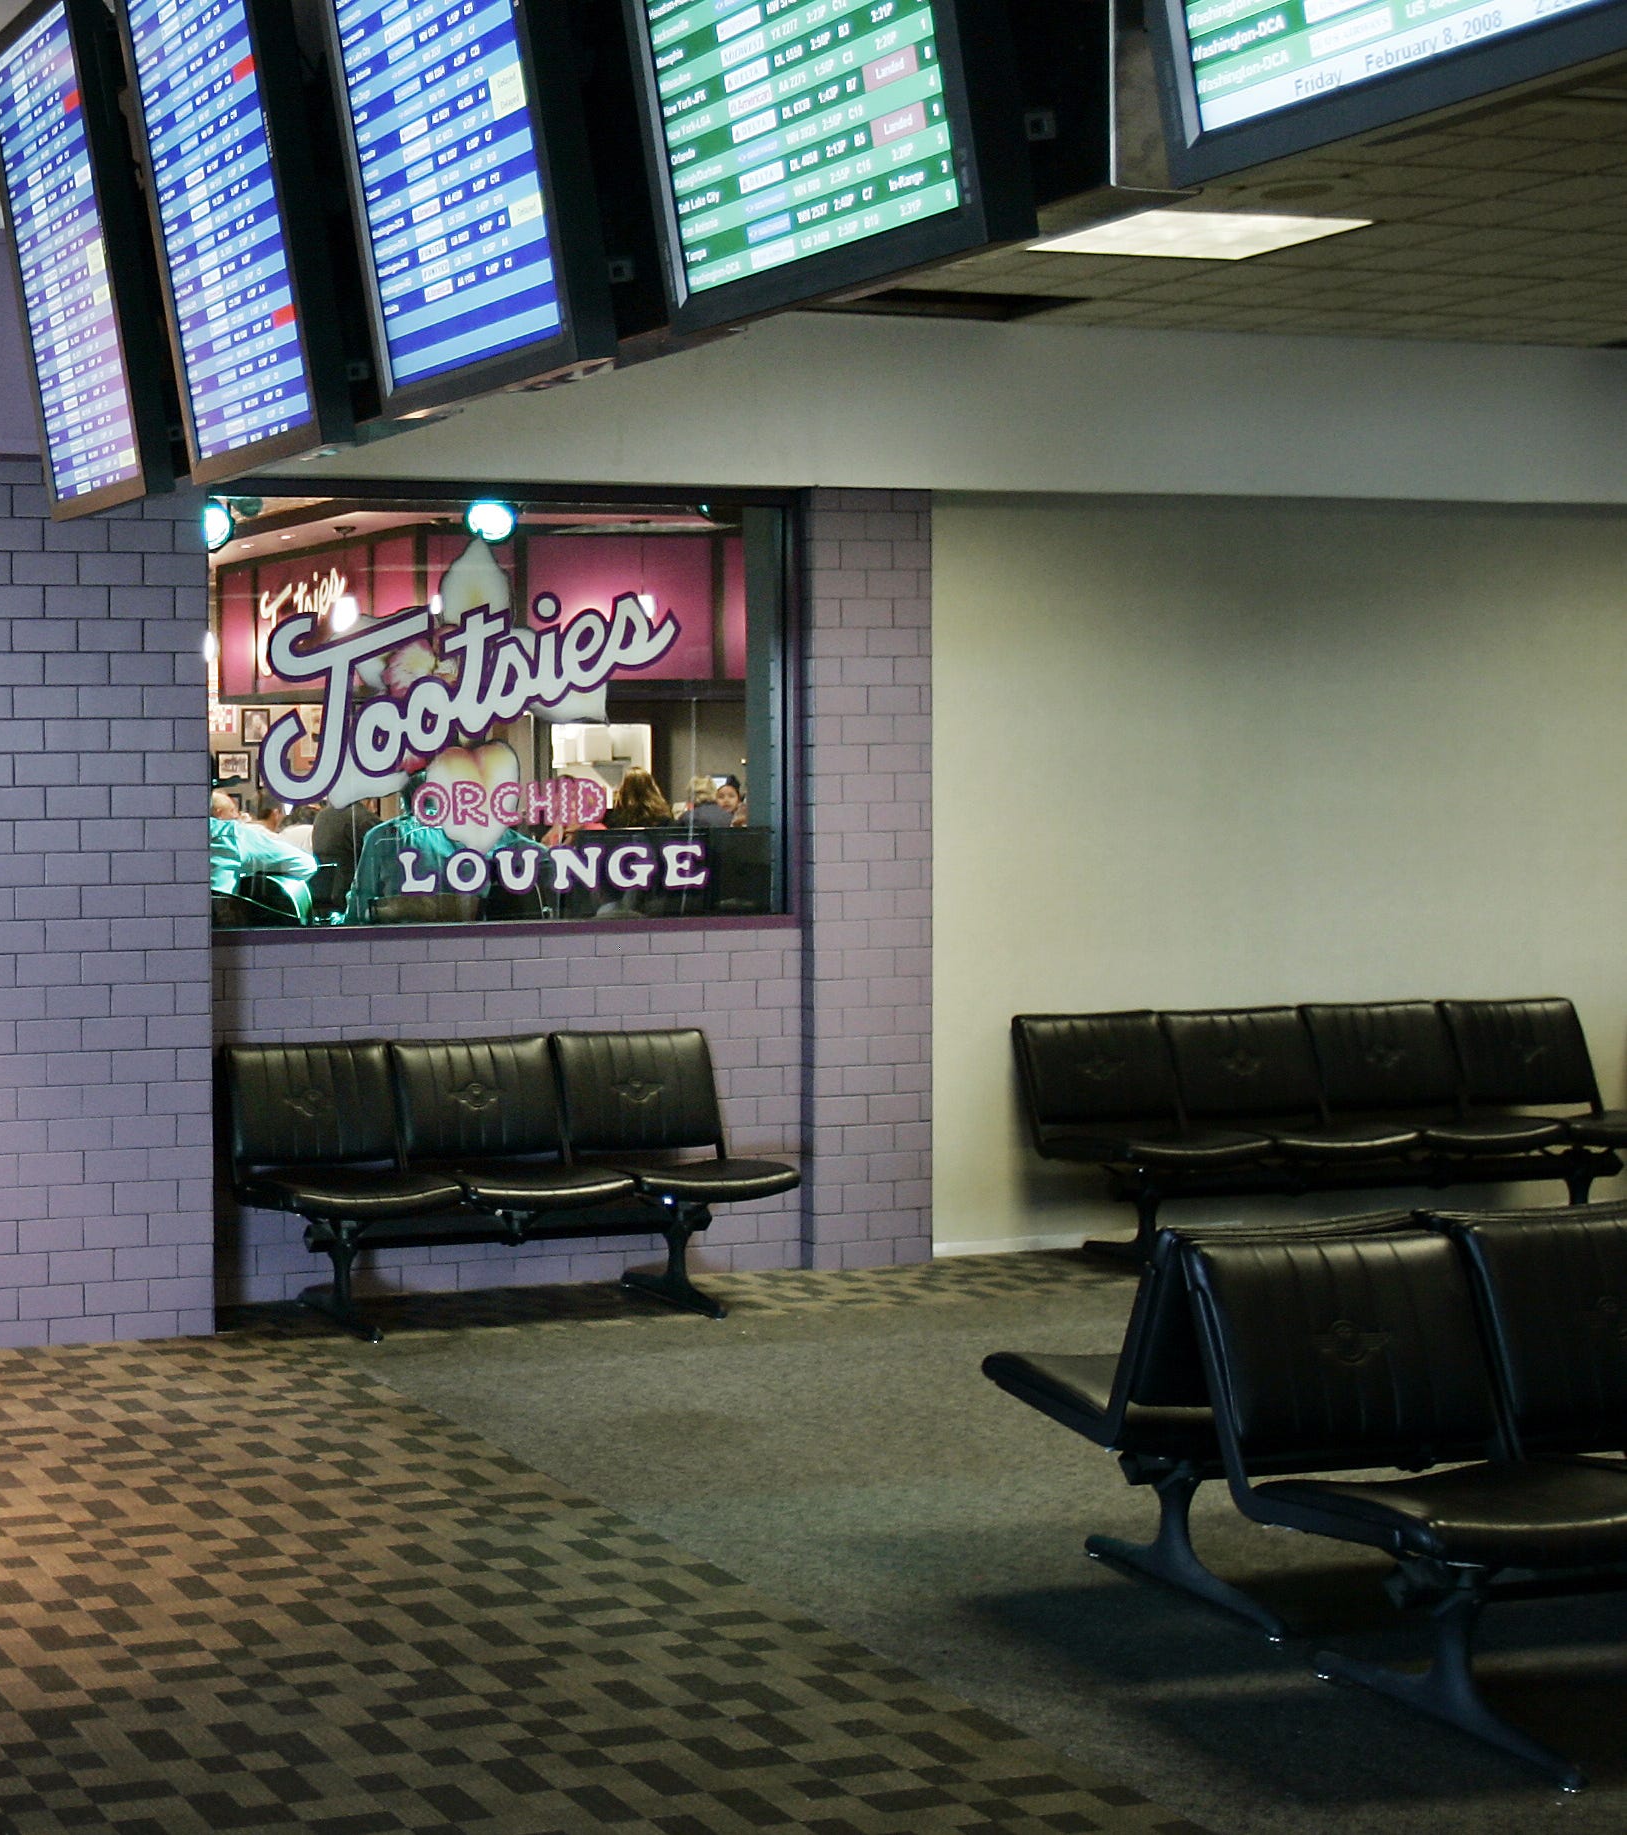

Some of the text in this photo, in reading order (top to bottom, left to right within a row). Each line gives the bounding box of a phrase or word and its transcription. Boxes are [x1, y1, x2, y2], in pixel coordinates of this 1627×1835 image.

[875, 57, 905, 80] Landed
[1294, 69, 1343, 97] Friday
[1364, 35, 1438, 72] February
[1463, 10, 1503, 38] 2008
[678, 201, 690, 214] Salt
[690, 195, 705, 209] Lake
[706, 189, 720, 205] City
[883, 113, 913, 135] Landed
[260, 591, 680, 806] Tootsies
[412, 778, 608, 828] ORCHID
[398, 843, 710, 896] LOUNGE
